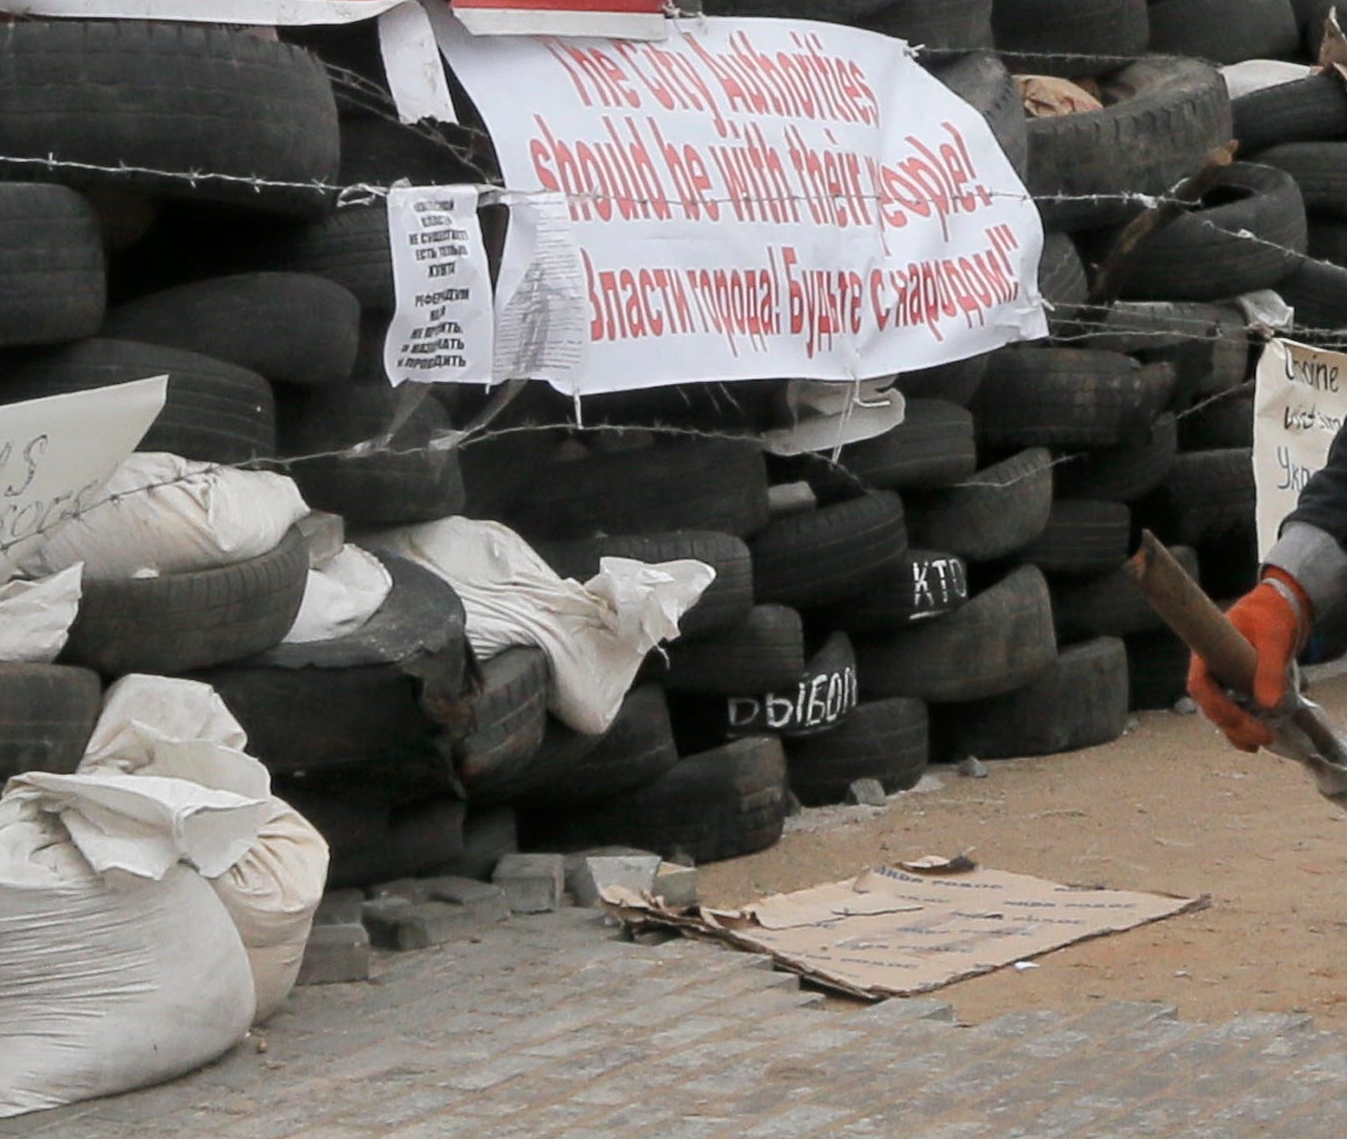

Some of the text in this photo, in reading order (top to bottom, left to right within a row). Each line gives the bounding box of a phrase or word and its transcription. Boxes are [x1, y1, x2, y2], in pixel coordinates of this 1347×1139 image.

[529, 113, 673, 223] should
[646, 115, 721, 223] be
[708, 120, 801, 225] with
[783, 123, 874, 229] their
